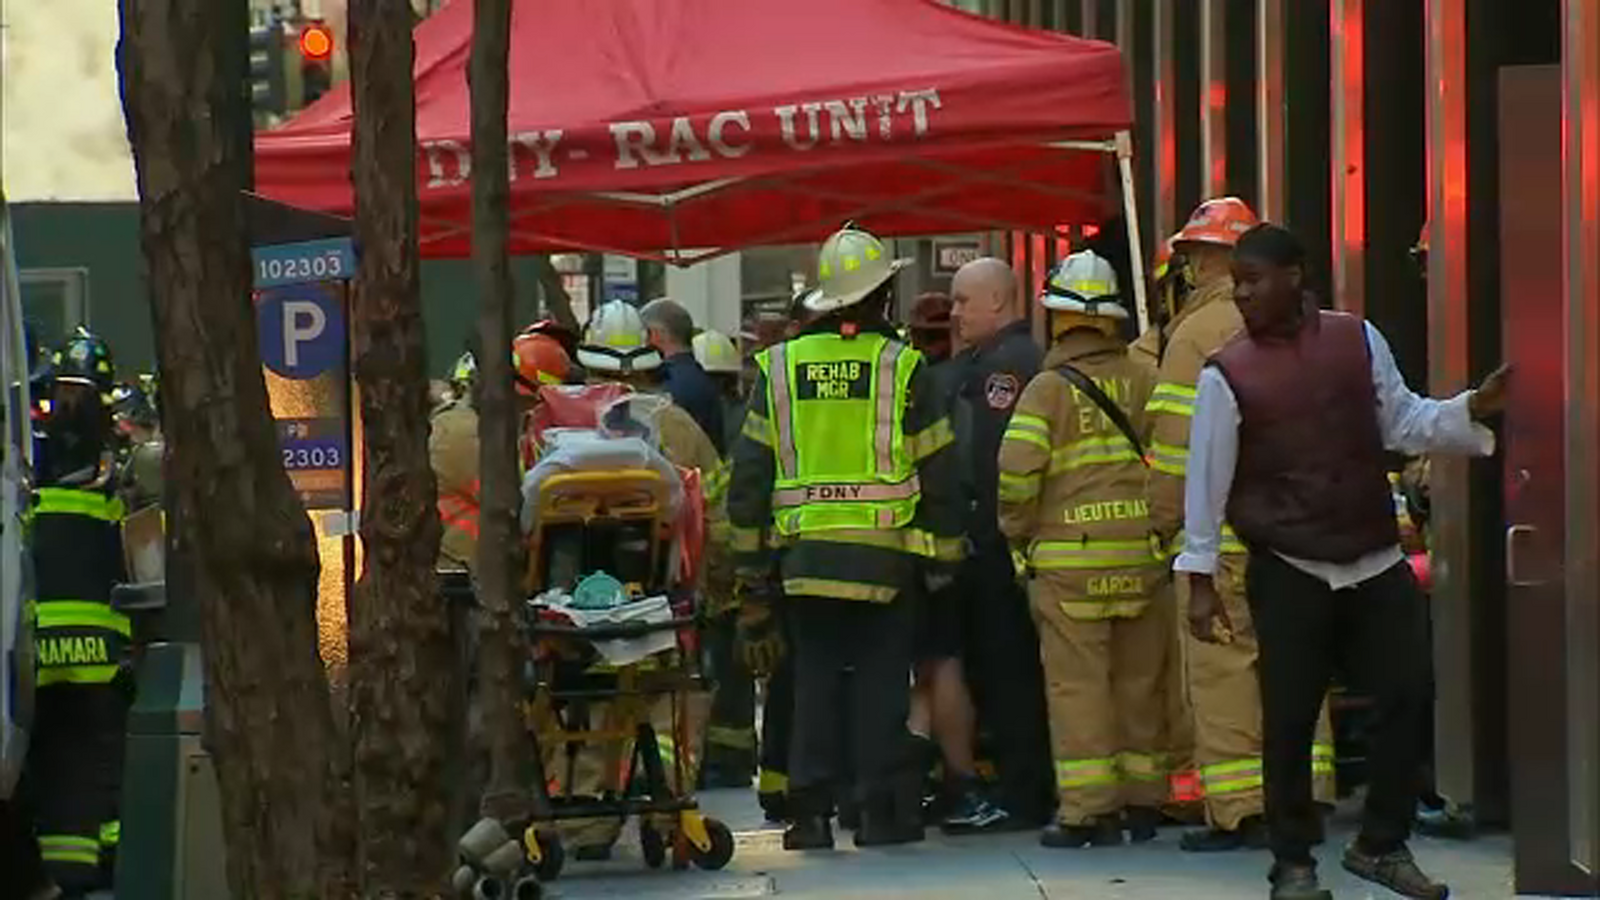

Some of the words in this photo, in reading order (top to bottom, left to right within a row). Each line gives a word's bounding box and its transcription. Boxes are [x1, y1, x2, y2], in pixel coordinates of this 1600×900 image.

[609, 110, 752, 169] RAC
[774, 88, 942, 150] UNIT
[260, 256, 341, 279] 102303
[283, 300, 326, 366] P
[806, 362, 861, 381] REHAB
[1070, 376, 1131, 405] FNY
[806, 486, 862, 499] FDNY
